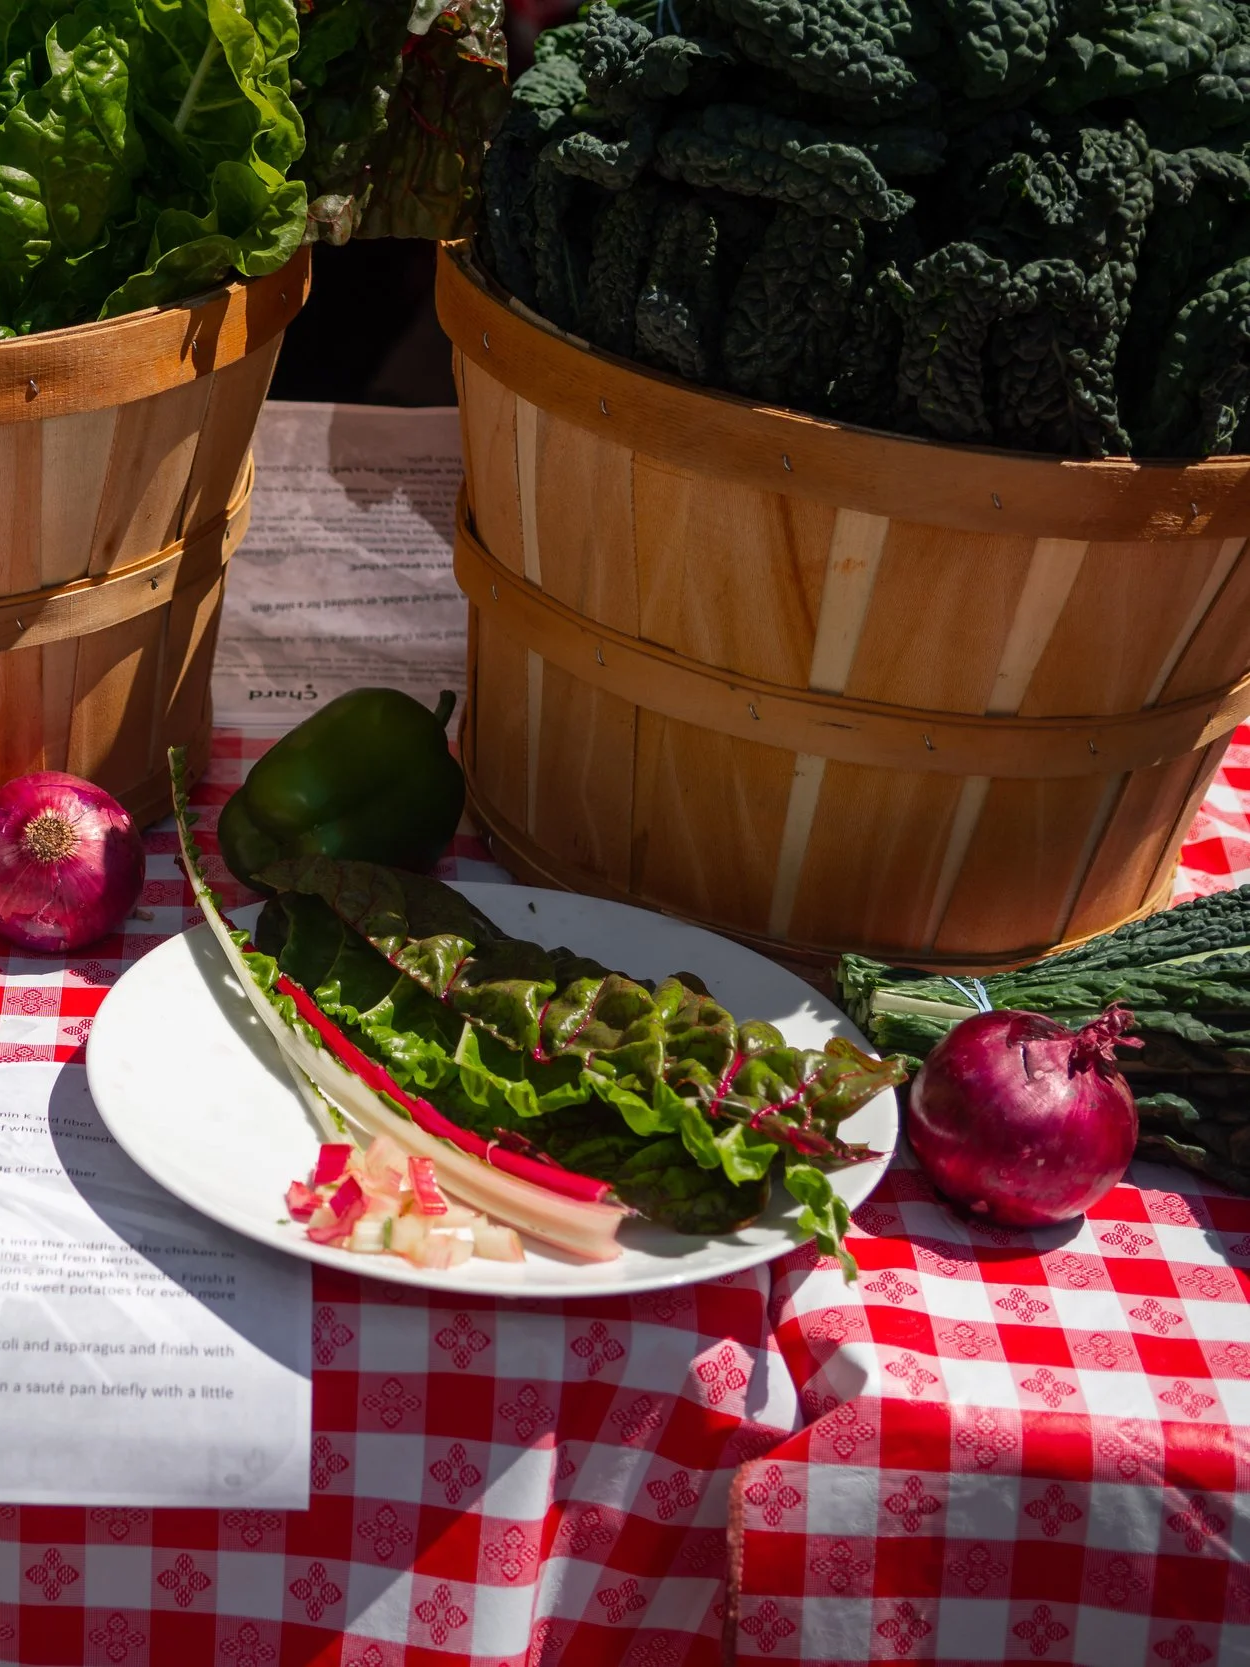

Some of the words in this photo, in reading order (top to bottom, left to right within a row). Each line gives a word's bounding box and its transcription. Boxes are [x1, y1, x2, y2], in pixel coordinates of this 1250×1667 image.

[248, 690, 319, 701] Chard
[38, 1267, 63, 1277] and
[67, 1268, 129, 1281] pumpkin
[23, 1283, 65, 1294] sweet
[69, 1283, 132, 1297] potatoes
[136, 1286, 155, 1297] for
[160, 1288, 193, 1298] even
[198, 1290, 236, 1300] more
[23, 1340, 50, 1352] and
[54, 1341, 125, 1356] asparagus
[129, 1343, 156, 1355] and
[160, 1344, 199, 1357] finish
[203, 1345, 236, 1358] with
[13, 1382, 22, 1393] a
[26, 1380, 65, 1394] sauté
[70, 1384, 97, 1396] pan
[101, 1382, 147, 1399] briefly
[152, 1384, 183, 1397] with
[188, 1387, 196, 1398] a
[200, 1386, 235, 1399] little
